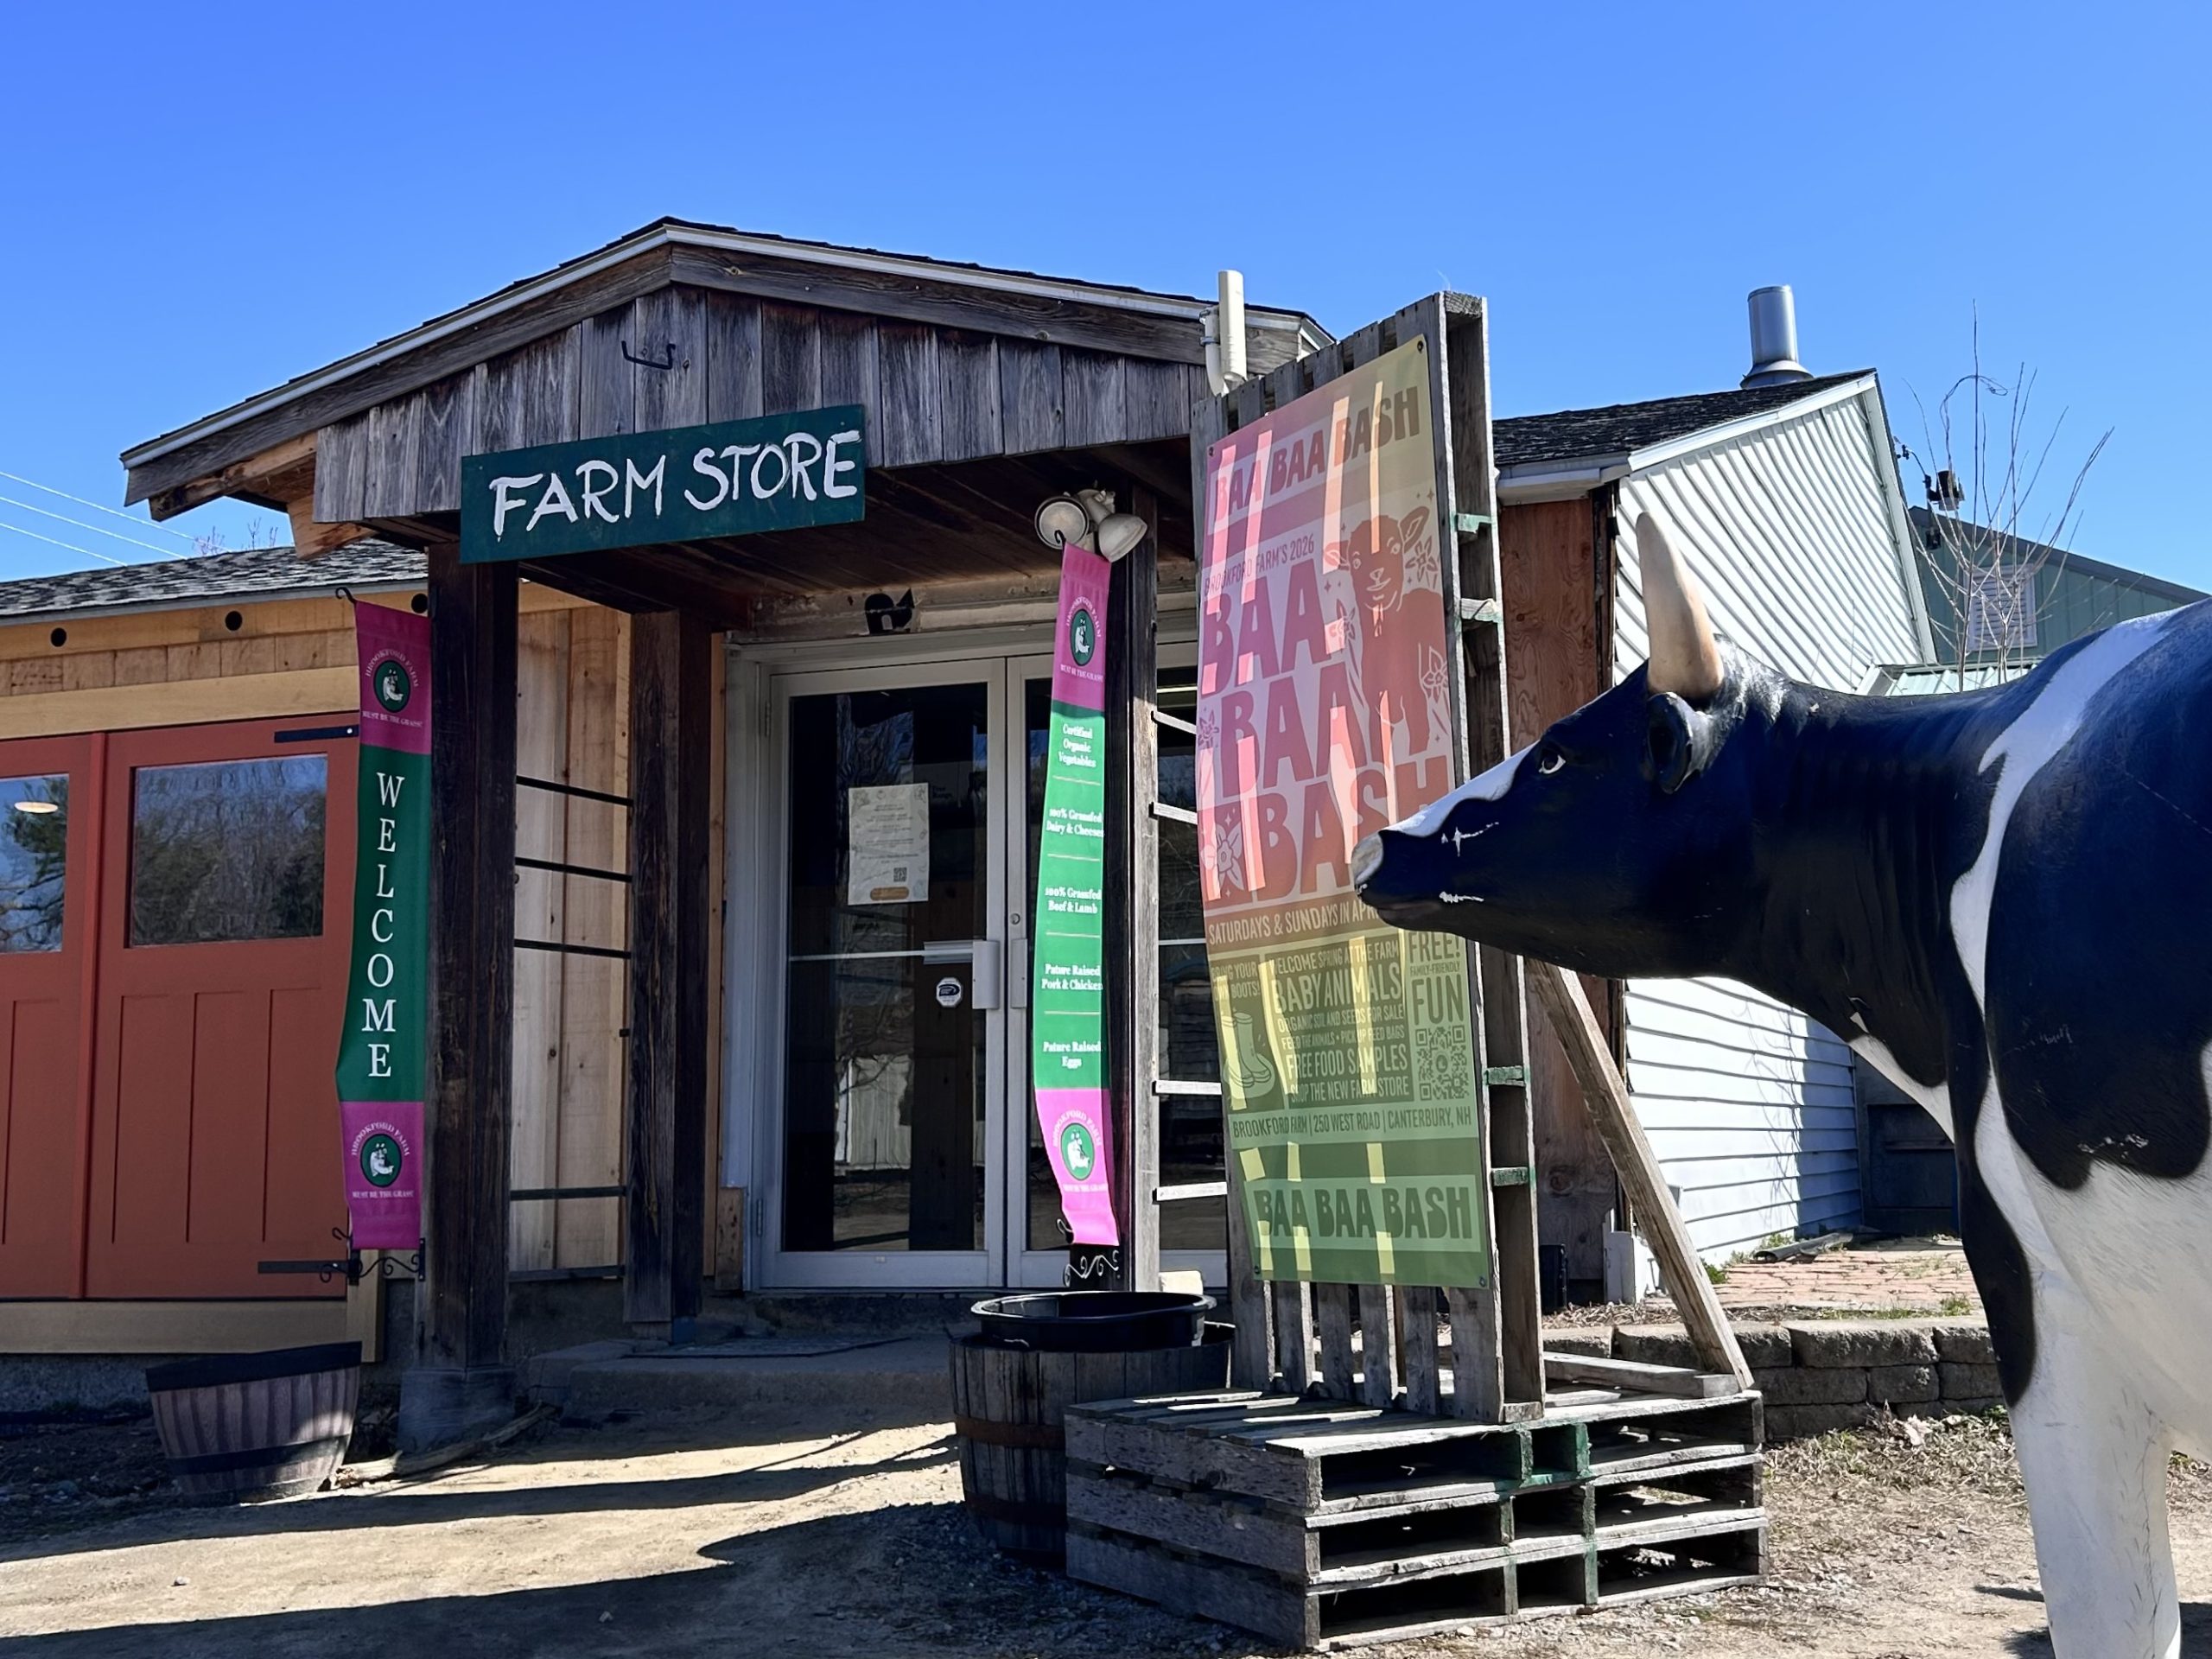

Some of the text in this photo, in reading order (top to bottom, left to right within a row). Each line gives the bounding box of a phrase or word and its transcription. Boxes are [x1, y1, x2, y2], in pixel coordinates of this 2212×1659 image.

[1215, 385, 1421, 523] BAA BAA BASH
[489, 430, 861, 541] FARM STORE
[1205, 533, 1315, 596] BROOKFORD FARM'S 2026
[1202, 558, 1332, 699] BAA
[1063, 723, 1093, 739] Certified
[1220, 662, 1368, 798] BAA
[1058, 751, 1096, 768] Vegetables
[1063, 738, 1091, 753] Organic
[1046, 820, 1065, 836] Dairy
[1065, 823, 1073, 835] &
[1068, 809, 1103, 823] Grassfed
[1045, 887, 1102, 900] 100% Grassfed
[1048, 900, 1098, 914] Beef & Lamb
[360, 772, 405, 1077] WELCOME
[1209, 915, 1271, 946] SATURDAYS
[1274, 913, 1284, 936] &
[1285, 904, 1338, 934] SUNDAYS
[1339, 901, 1351, 925] IN
[1268, 953, 1319, 976] WELCOME
[1319, 947, 1343, 968] SPRING
[1354, 943, 1375, 963] THE
[1375, 939, 1400, 962] FARM
[1408, 932, 1460, 963] FREE!
[1071, 964, 1101, 976] Raised
[1211, 961, 1258, 982] BRING YOUR
[1041, 978, 1103, 991] Pork & Chicken
[1230, 979, 1261, 999] BOOTS!
[1272, 962, 1402, 1014] BABY ANIMALS
[1411, 974, 1465, 1026] FUN
[1278, 1014, 1313, 1033] ORGANIC
[1327, 1011, 1340, 1027] AND
[1342, 1008, 1367, 1026] SEEDS
[1367, 1006, 1382, 1023] FOR
[1383, 1003, 1404, 1021] SALE
[1071, 1040, 1102, 1053] Raised
[1281, 1035, 1301, 1051] FEED
[1357, 1027, 1367, 1043] UP
[1368, 1027, 1385, 1042] FEED
[1386, 1024, 1405, 1040] BAGS
[1061, 1056, 1082, 1070] Eggs
[1286, 1044, 1408, 1080] FREE FOOD SAMPLES
[1310, 1082, 1325, 1102] THE
[1328, 1080, 1349, 1100] NEW
[1351, 1077, 1377, 1099] FARM
[1378, 1075, 1410, 1097] STORE
[1233, 1116, 1289, 1138] BROOKFORD
[1290, 1115, 1307, 1134] FARM
[1313, 1113, 1330, 1134] 250
[1331, 1112, 1355, 1132] WEST
[1356, 1110, 1381, 1131] ROAD
[1388, 1107, 1454, 1129] CANTERBURY,
[1455, 1105, 1472, 1126] NH
[1253, 1186, 1473, 1241] BAA BAA BASH
